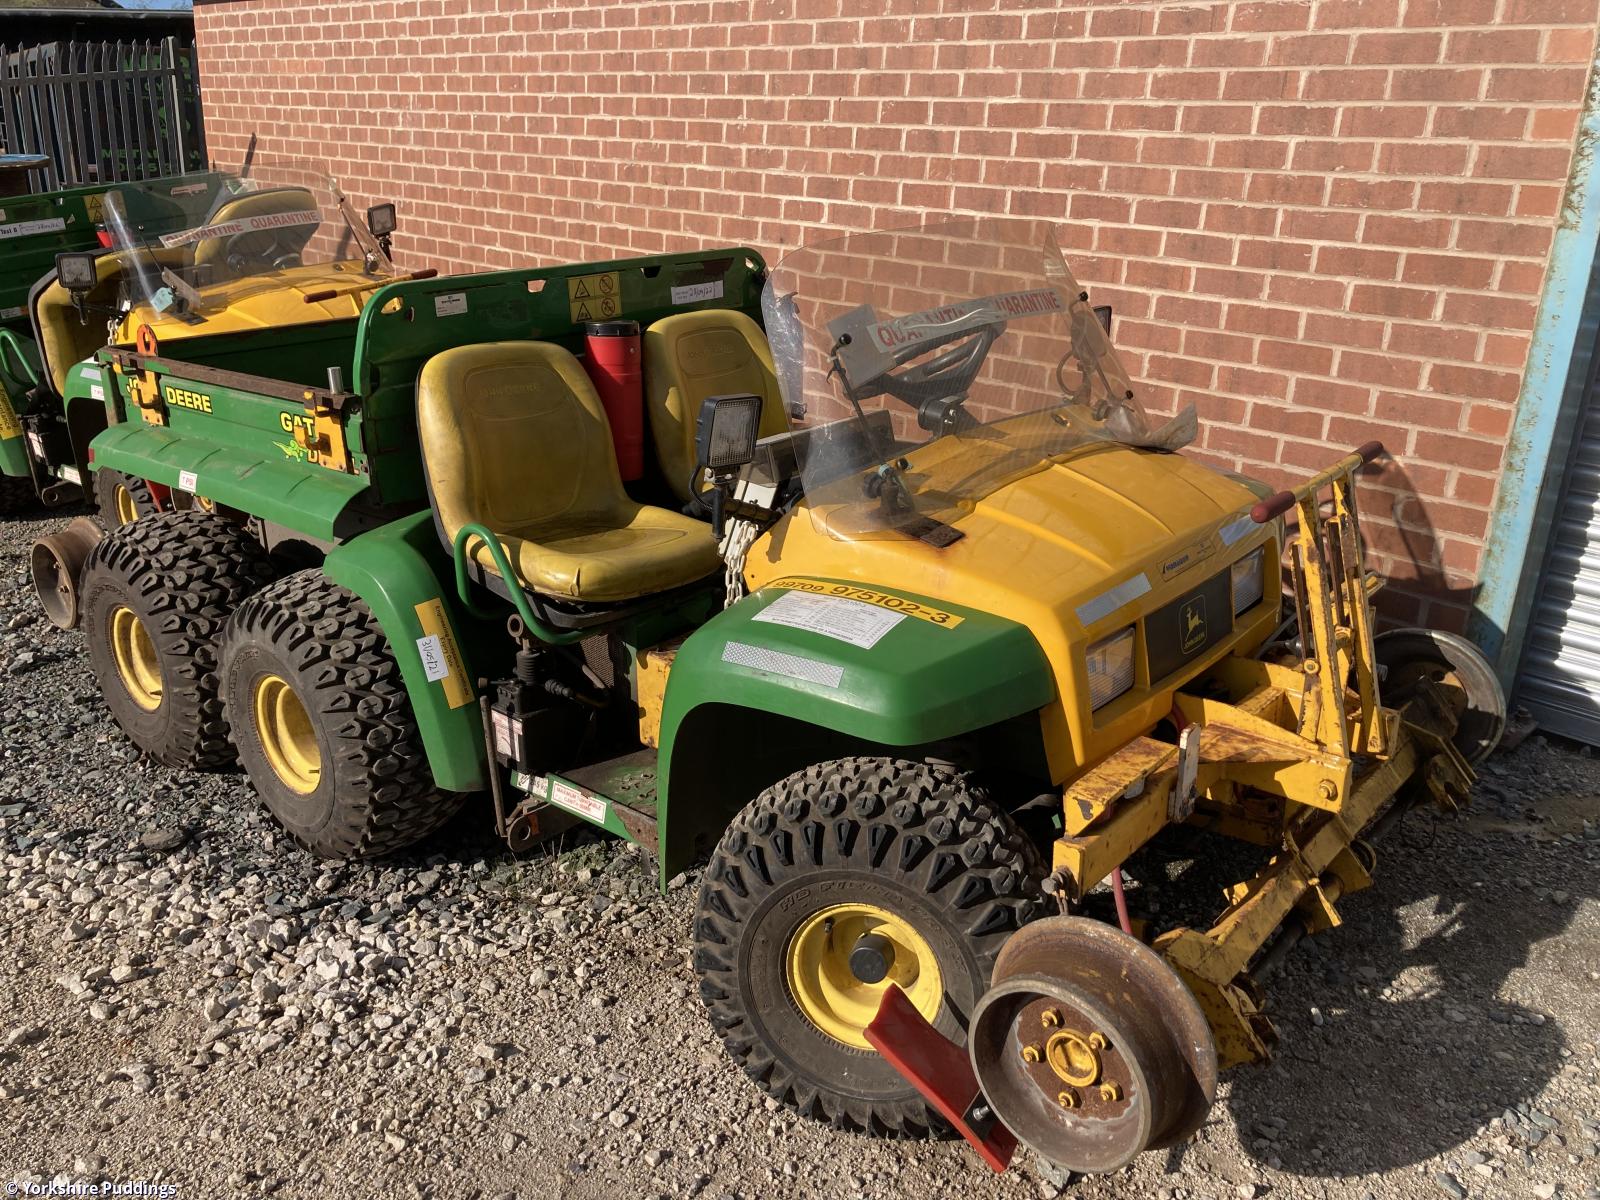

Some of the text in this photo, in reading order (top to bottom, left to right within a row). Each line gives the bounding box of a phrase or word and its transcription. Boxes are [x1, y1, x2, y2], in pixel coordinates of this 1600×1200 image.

[251, 210, 319, 229] QUARANTINE
[165, 385, 213, 415] DEERE
[829, 585, 951, 624] 975102-3
